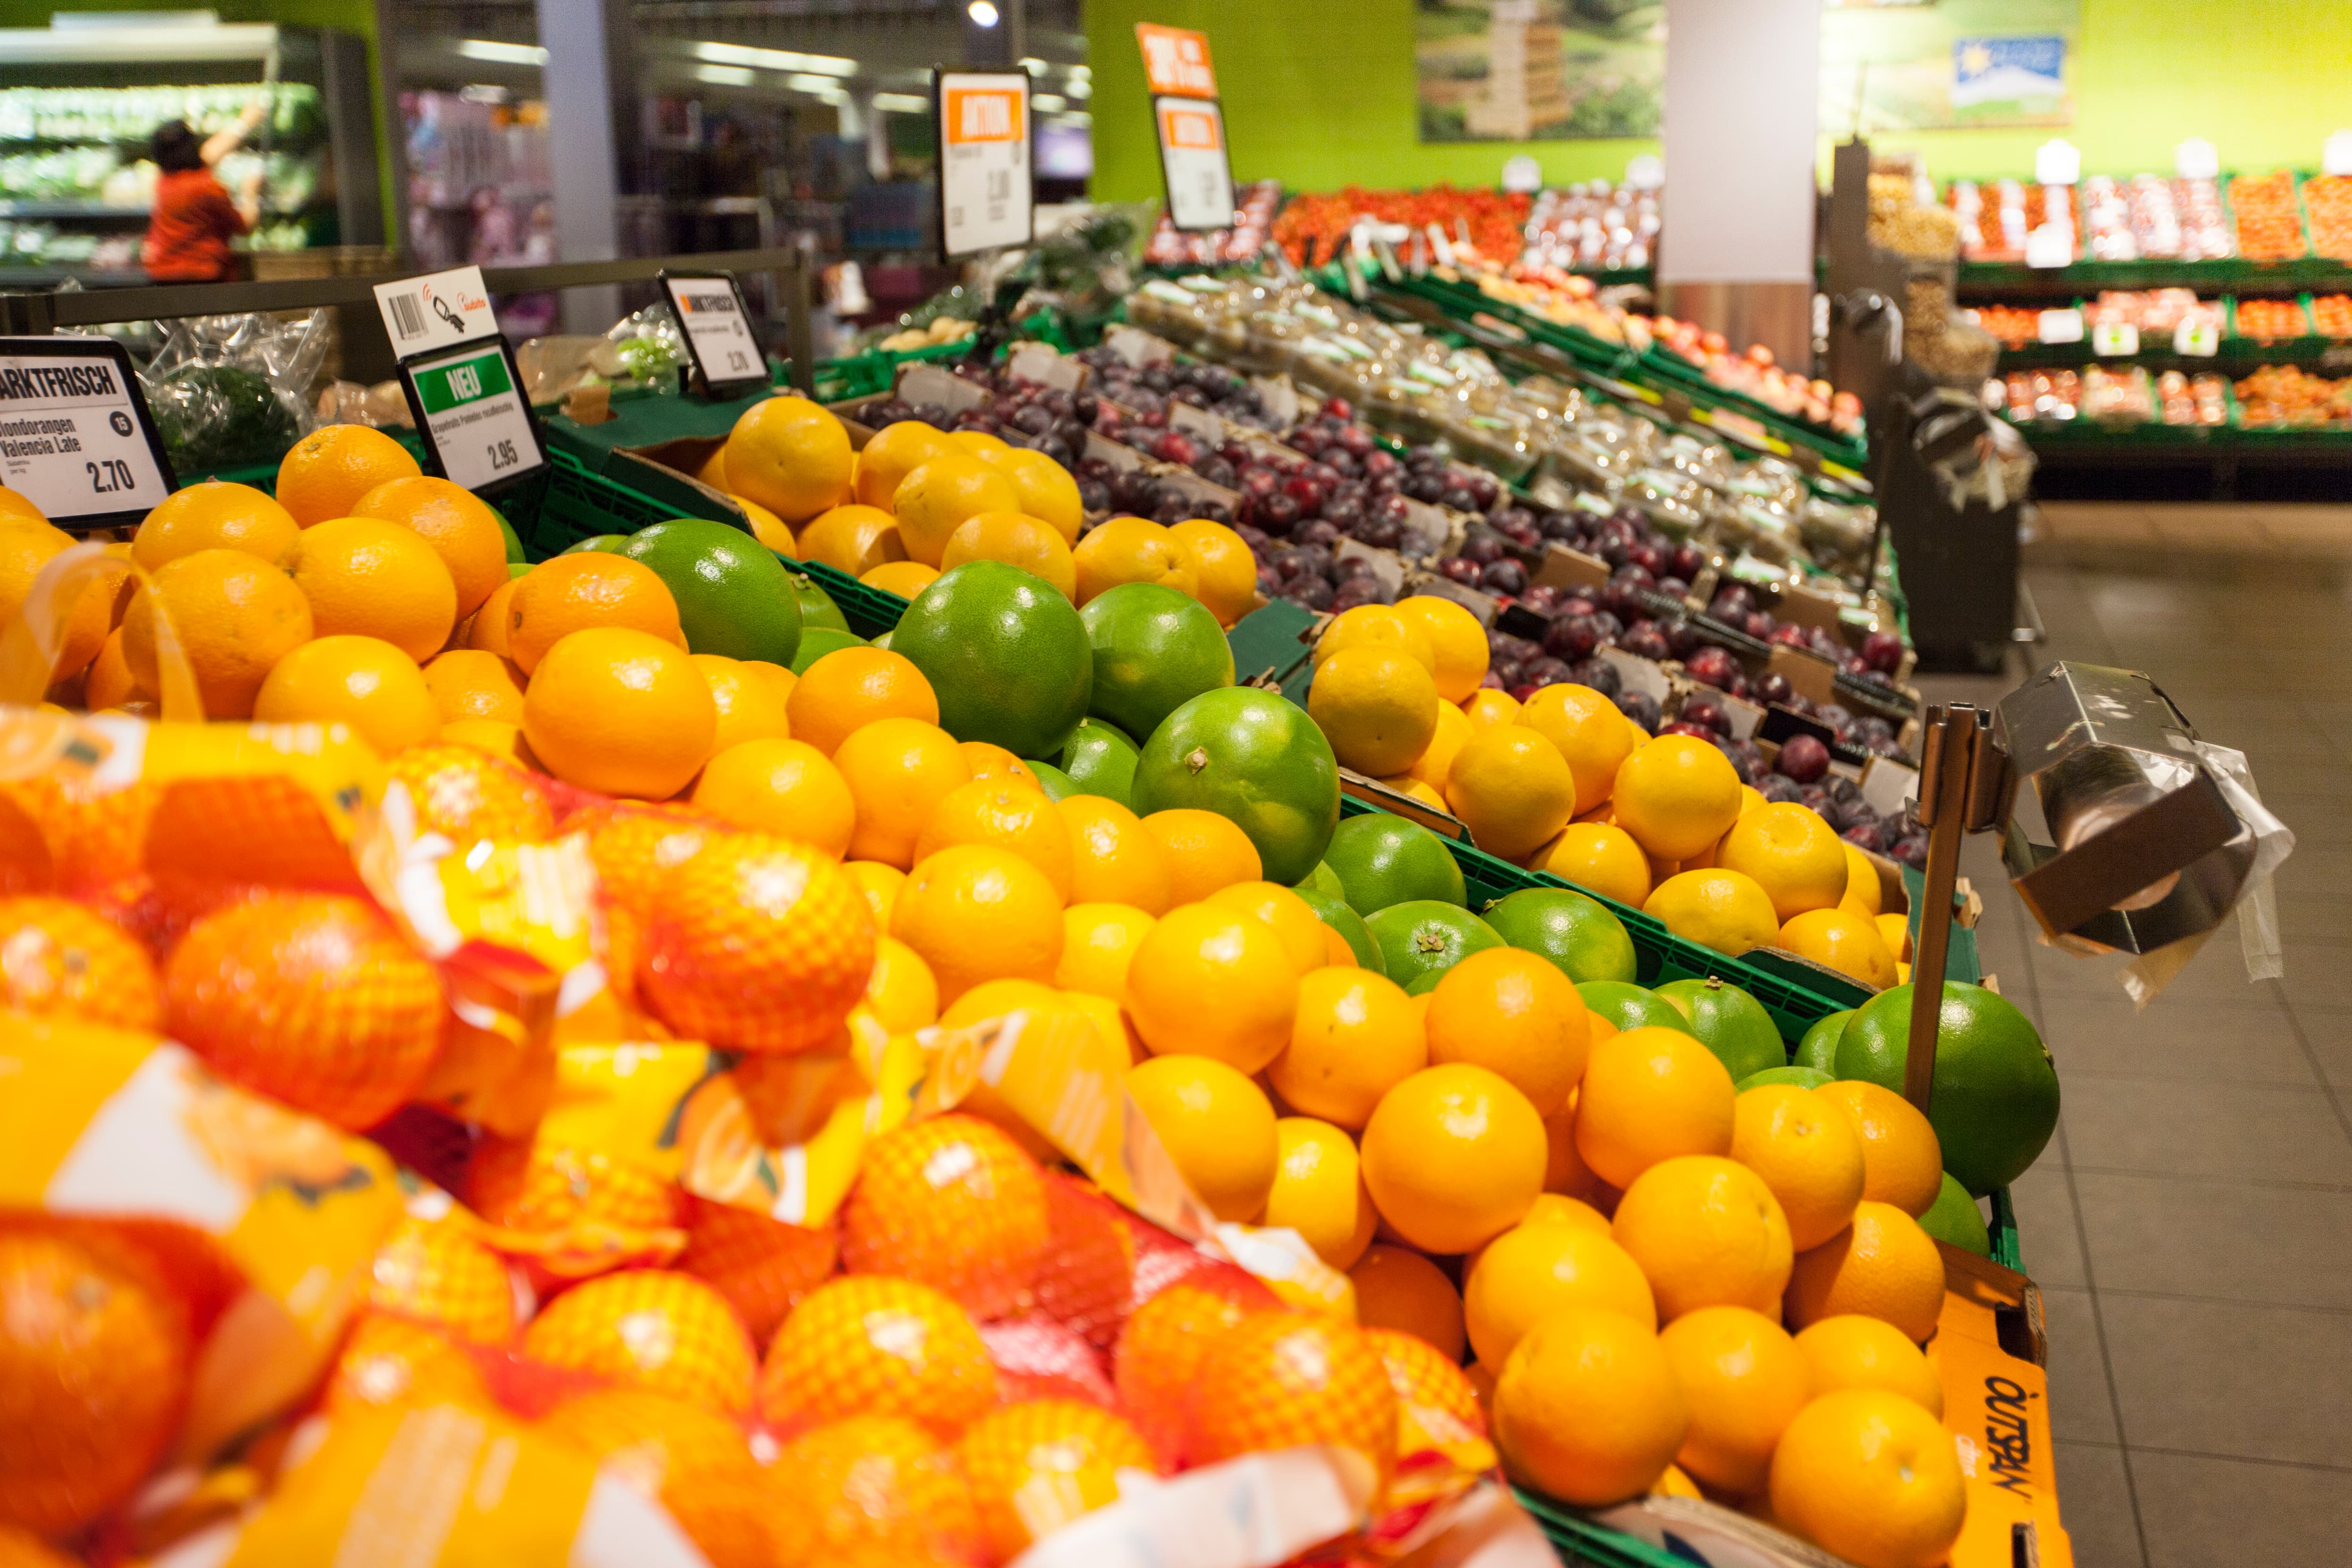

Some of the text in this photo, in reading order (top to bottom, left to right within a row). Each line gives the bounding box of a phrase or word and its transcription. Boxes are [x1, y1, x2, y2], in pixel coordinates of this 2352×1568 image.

[0, 366, 117, 400] ARKTFRISCH
[445, 364, 482, 401] NEU
[0, 419, 76, 437] londorangen
[115, 417, 128, 430] 15
[0, 436, 82, 457] Valencia Late
[487, 439, 518, 470] 2.95
[86, 459, 135, 493] 2.70
[1984, 1375, 2033, 1501] OUTSPAN
